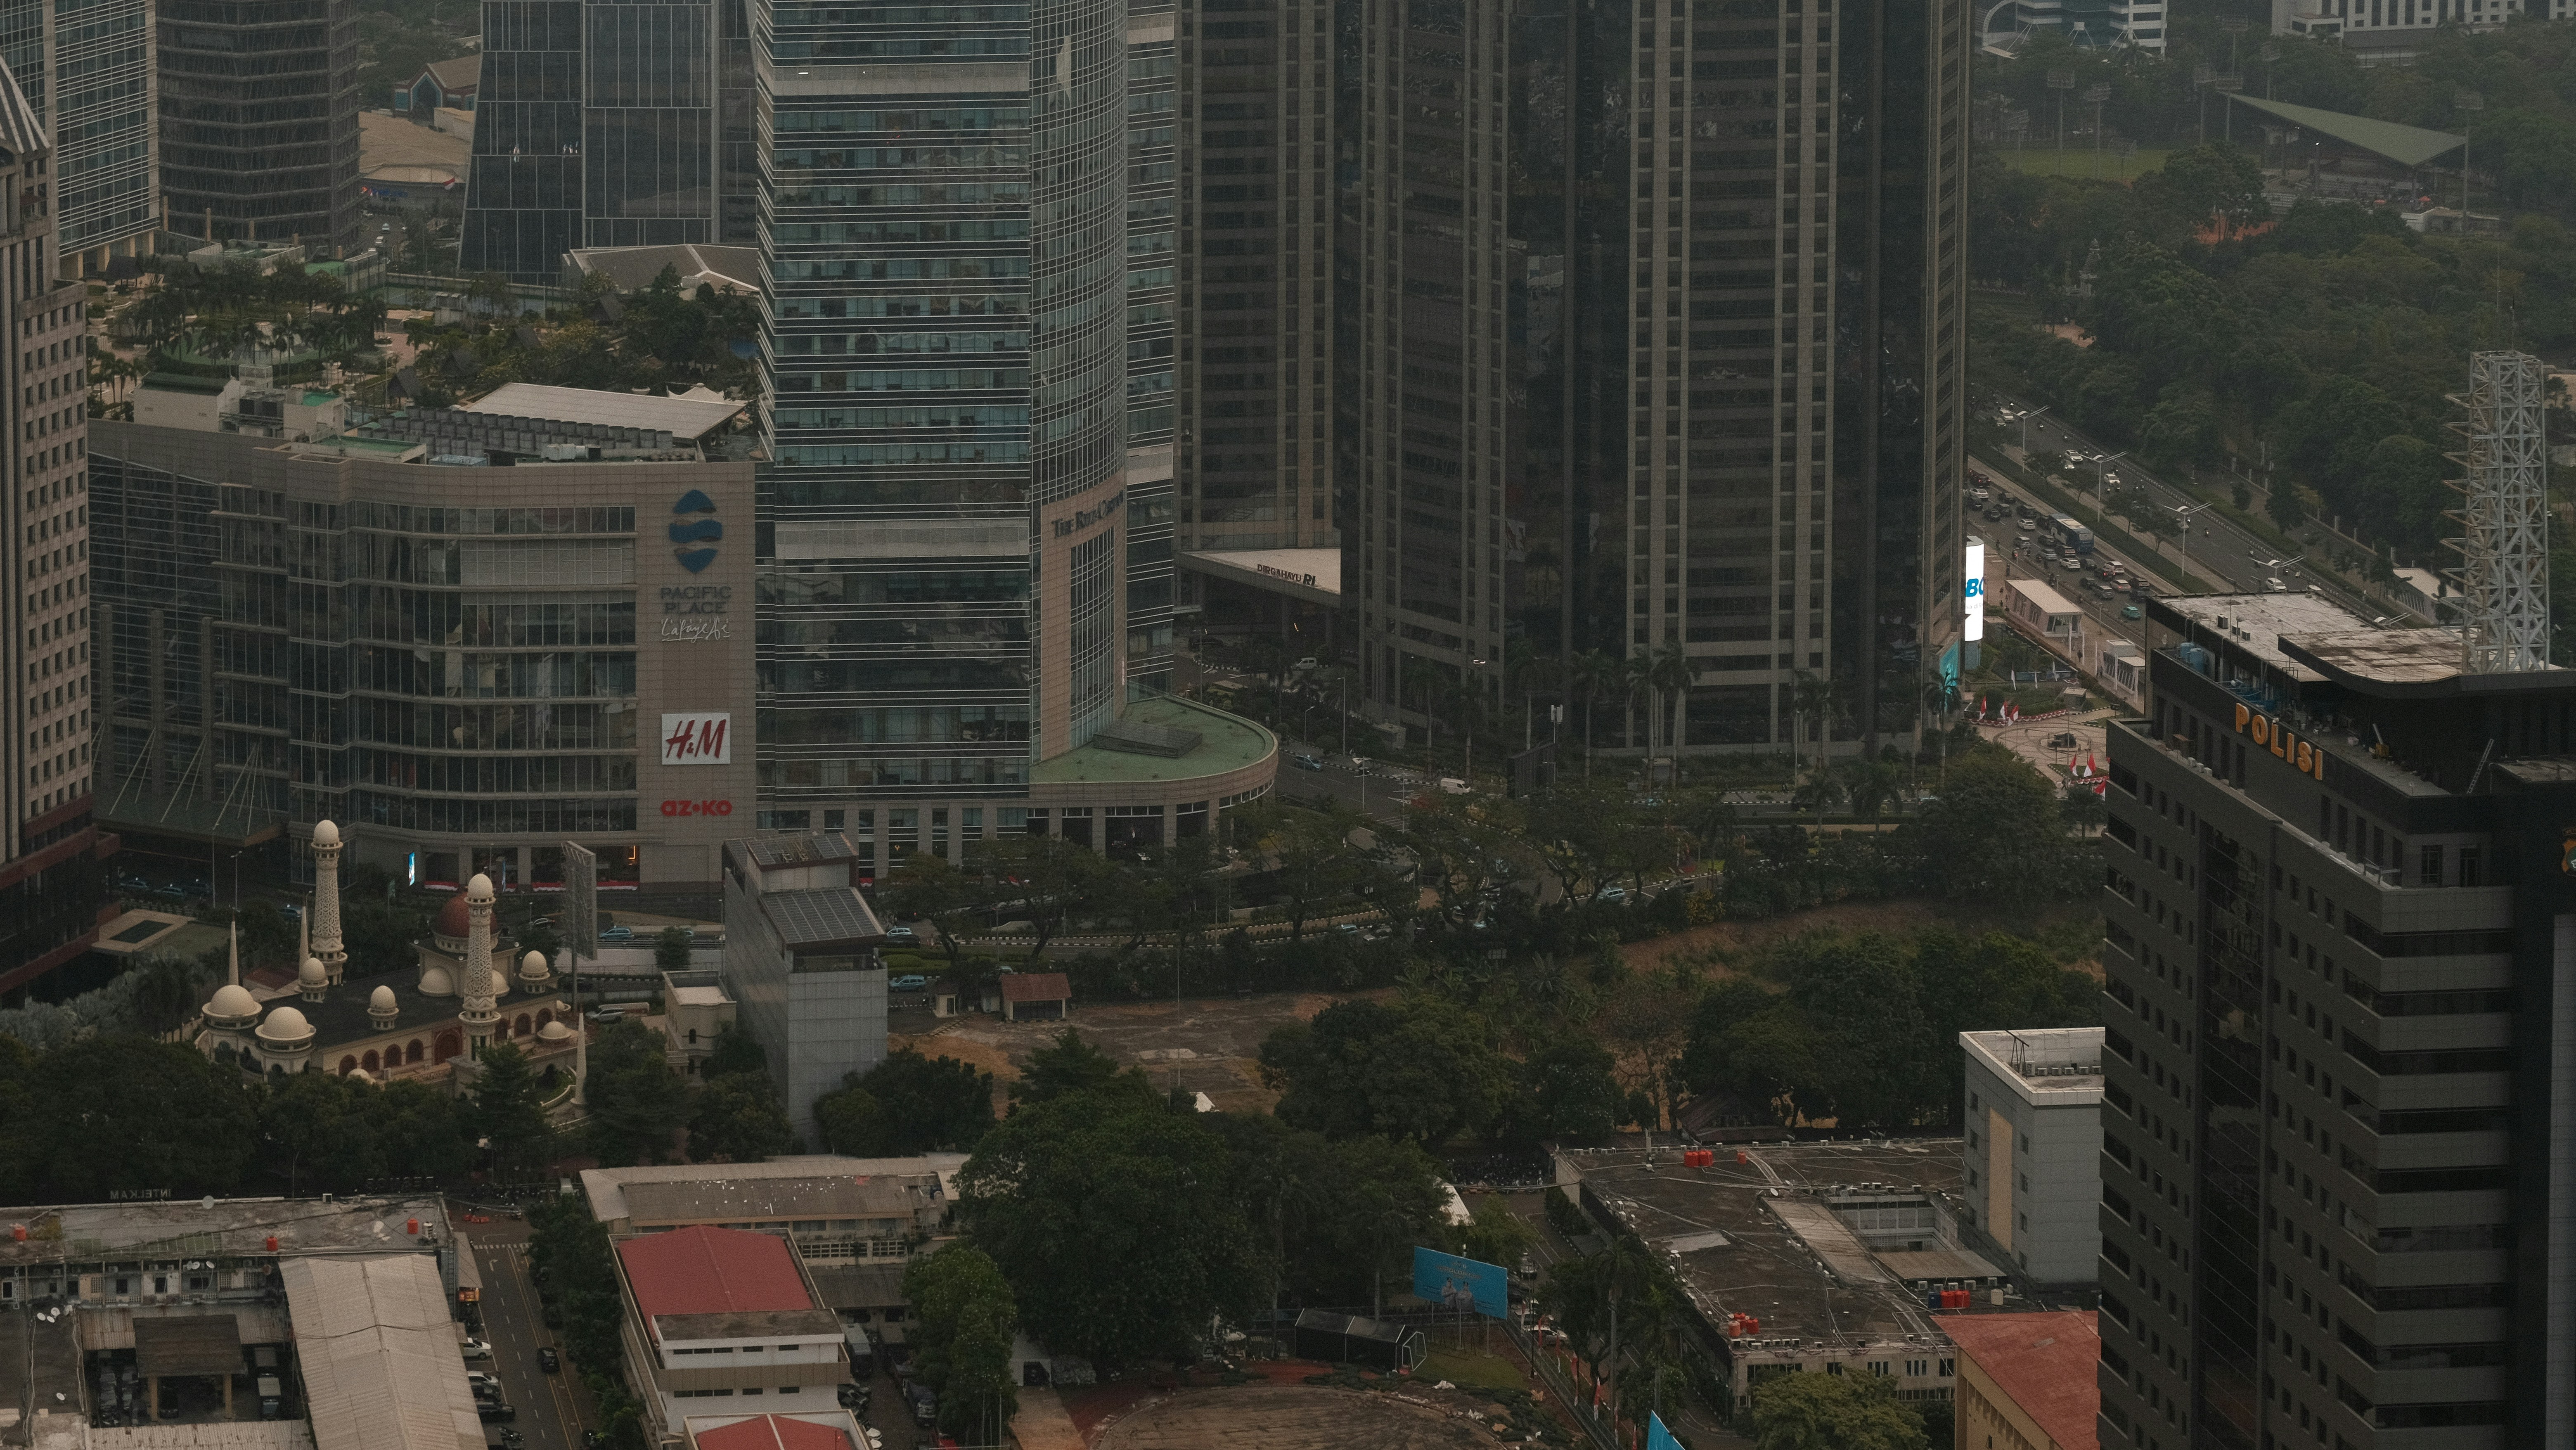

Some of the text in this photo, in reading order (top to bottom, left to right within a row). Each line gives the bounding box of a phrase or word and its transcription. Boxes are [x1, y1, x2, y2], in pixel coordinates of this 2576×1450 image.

[1257, 564, 1316, 586] DIRGAHAYU RI
[661, 586, 731, 599] PACIFIC
[664, 602, 727, 614] PLACE
[661, 616, 729, 643] Lafayette
[666, 719, 727, 759] H&M
[2235, 702, 2323, 781] POLISI
